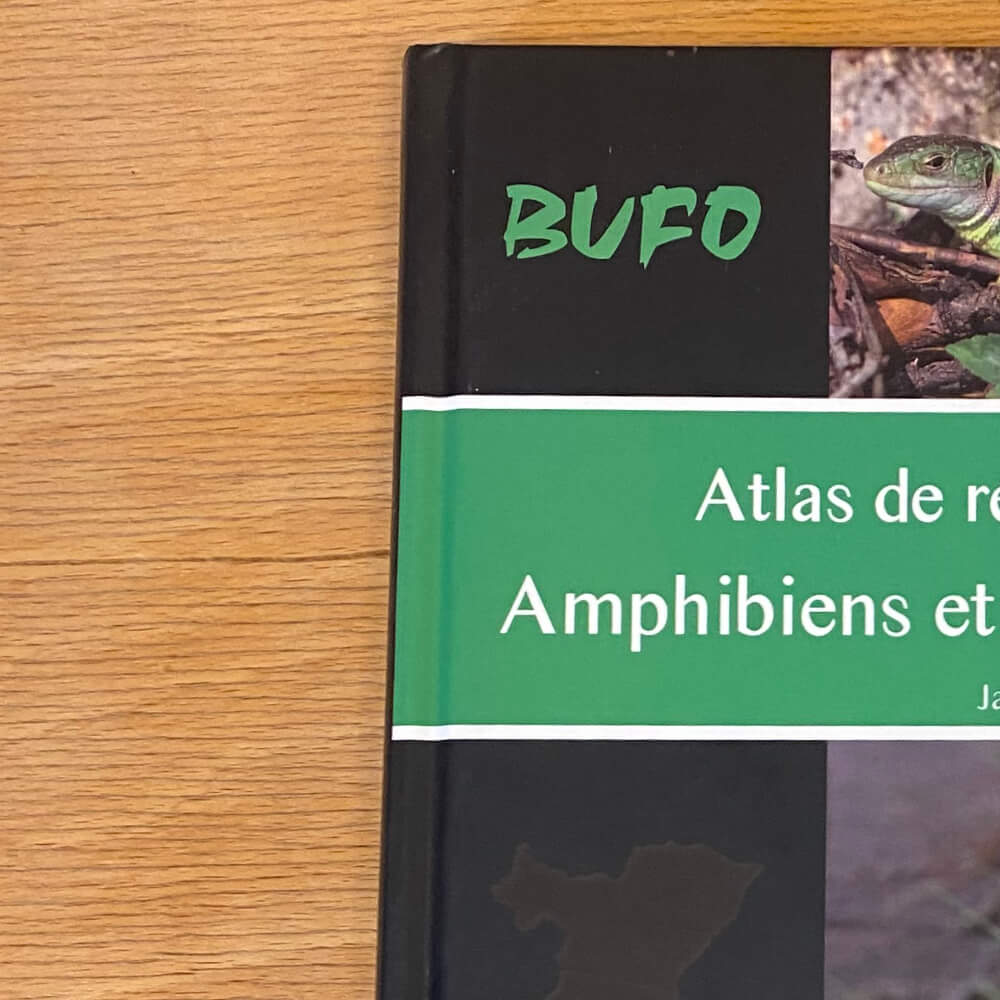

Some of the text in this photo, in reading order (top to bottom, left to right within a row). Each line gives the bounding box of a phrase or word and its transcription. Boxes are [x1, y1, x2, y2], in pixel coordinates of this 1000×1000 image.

[503, 183, 761, 267] BUFO
[695, 466, 854, 523] Atlas
[874, 467, 944, 524] de
[499, 574, 911, 653] Amphibiens
[934, 583, 996, 637] et
